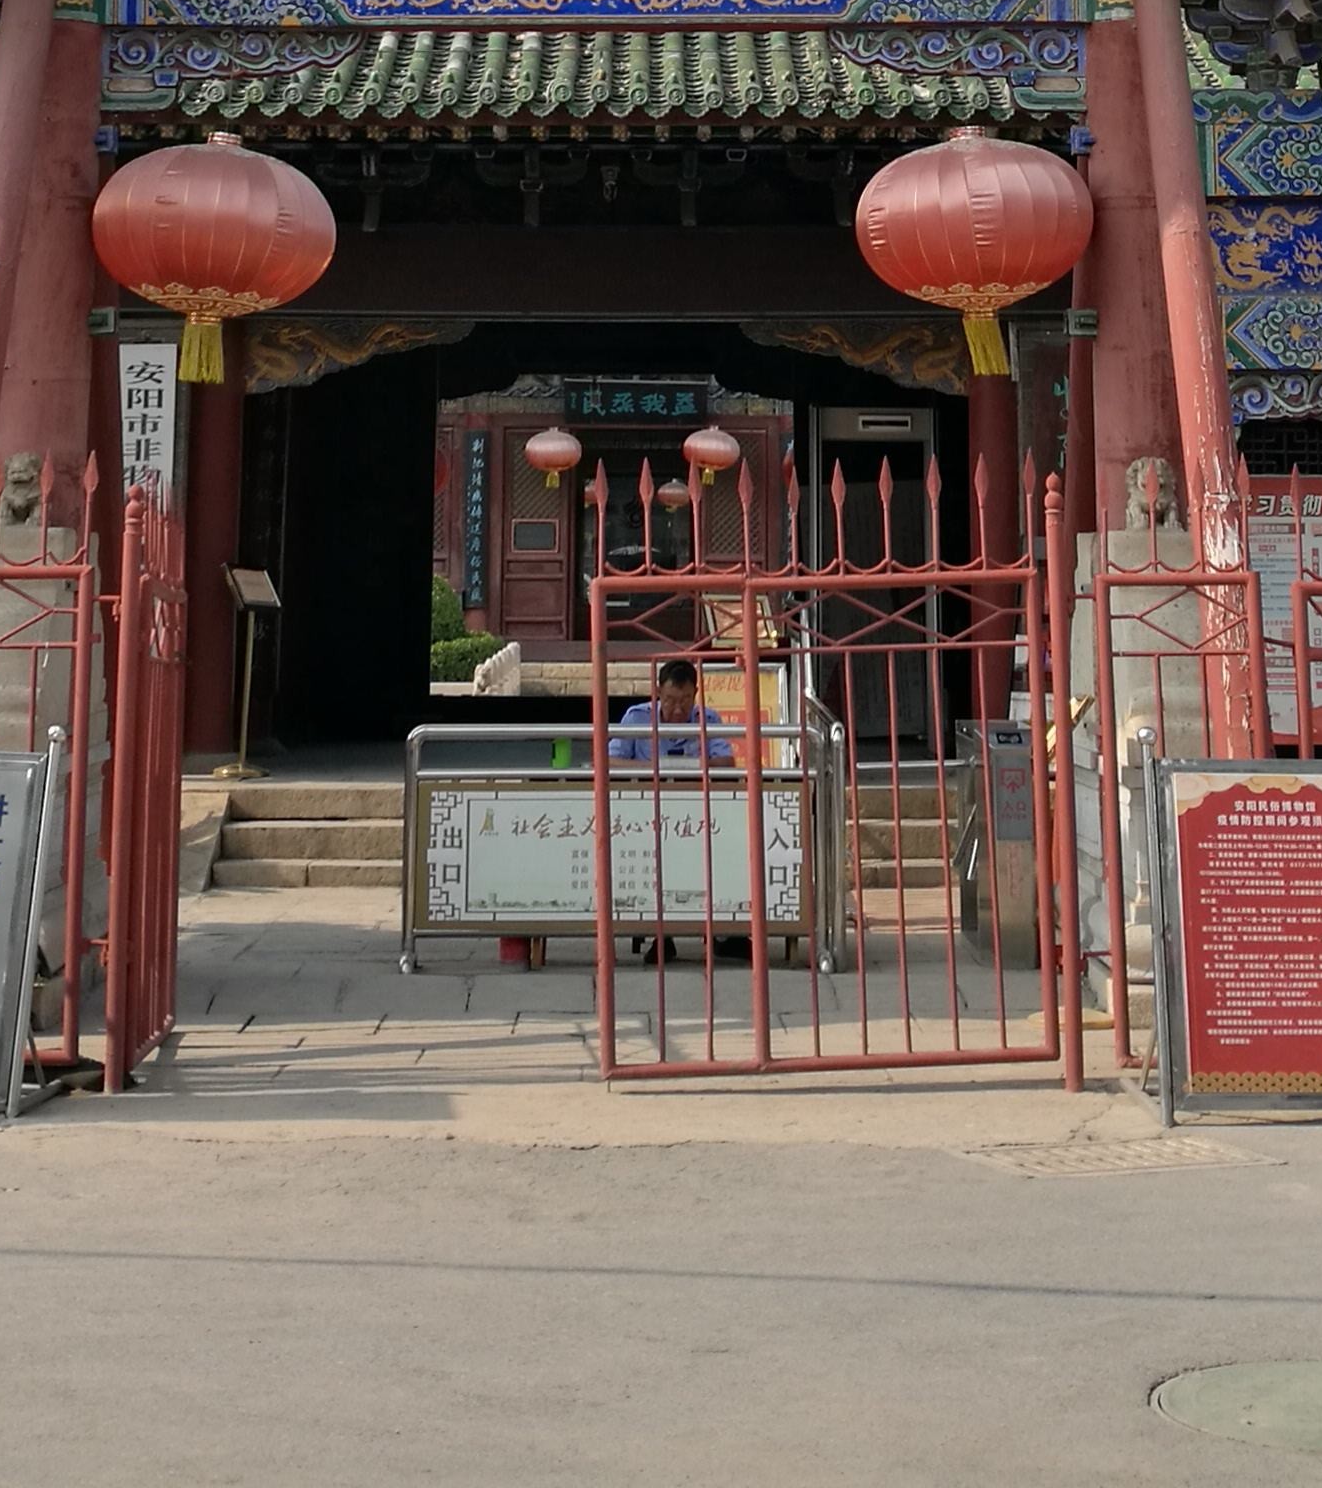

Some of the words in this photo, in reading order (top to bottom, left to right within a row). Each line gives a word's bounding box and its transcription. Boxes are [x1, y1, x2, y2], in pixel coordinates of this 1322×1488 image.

[1234, 800, 1316, 812] 安阳民俗博物馆
[442, 826, 463, 884] 出口
[767, 828, 790, 886] 入口
